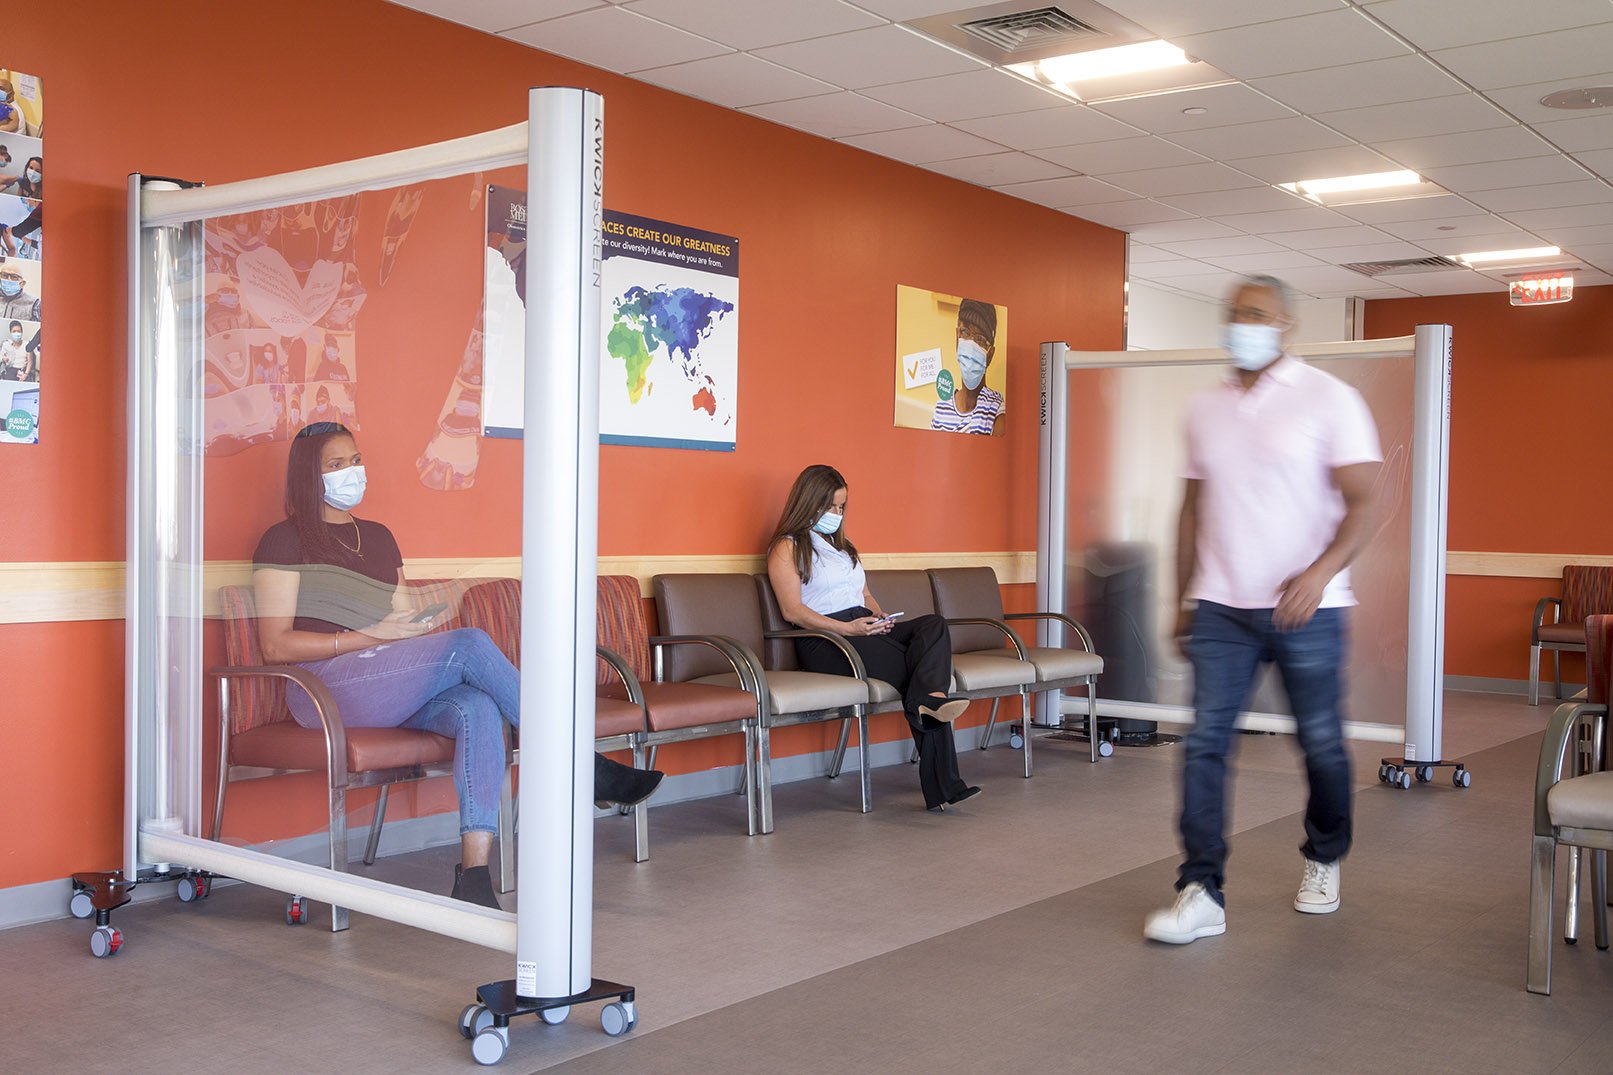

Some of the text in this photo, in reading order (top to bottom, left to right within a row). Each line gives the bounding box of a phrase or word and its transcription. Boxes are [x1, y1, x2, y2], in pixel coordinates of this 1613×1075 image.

[510, 203, 527, 213] BOS
[602, 220, 731, 257] ACES CREATE OUR GREATNESS
[610, 240, 621, 248] our
[622, 241, 651, 256] diversity!
[651, 246, 667, 258] Mark
[667, 250, 686, 261] where
[686, 255, 698, 264] you
[698, 257, 708, 265] are
[937, 383, 951, 394] Proud
[8, 417, 32, 425] #BMC
[8, 423, 30, 431] Proud
